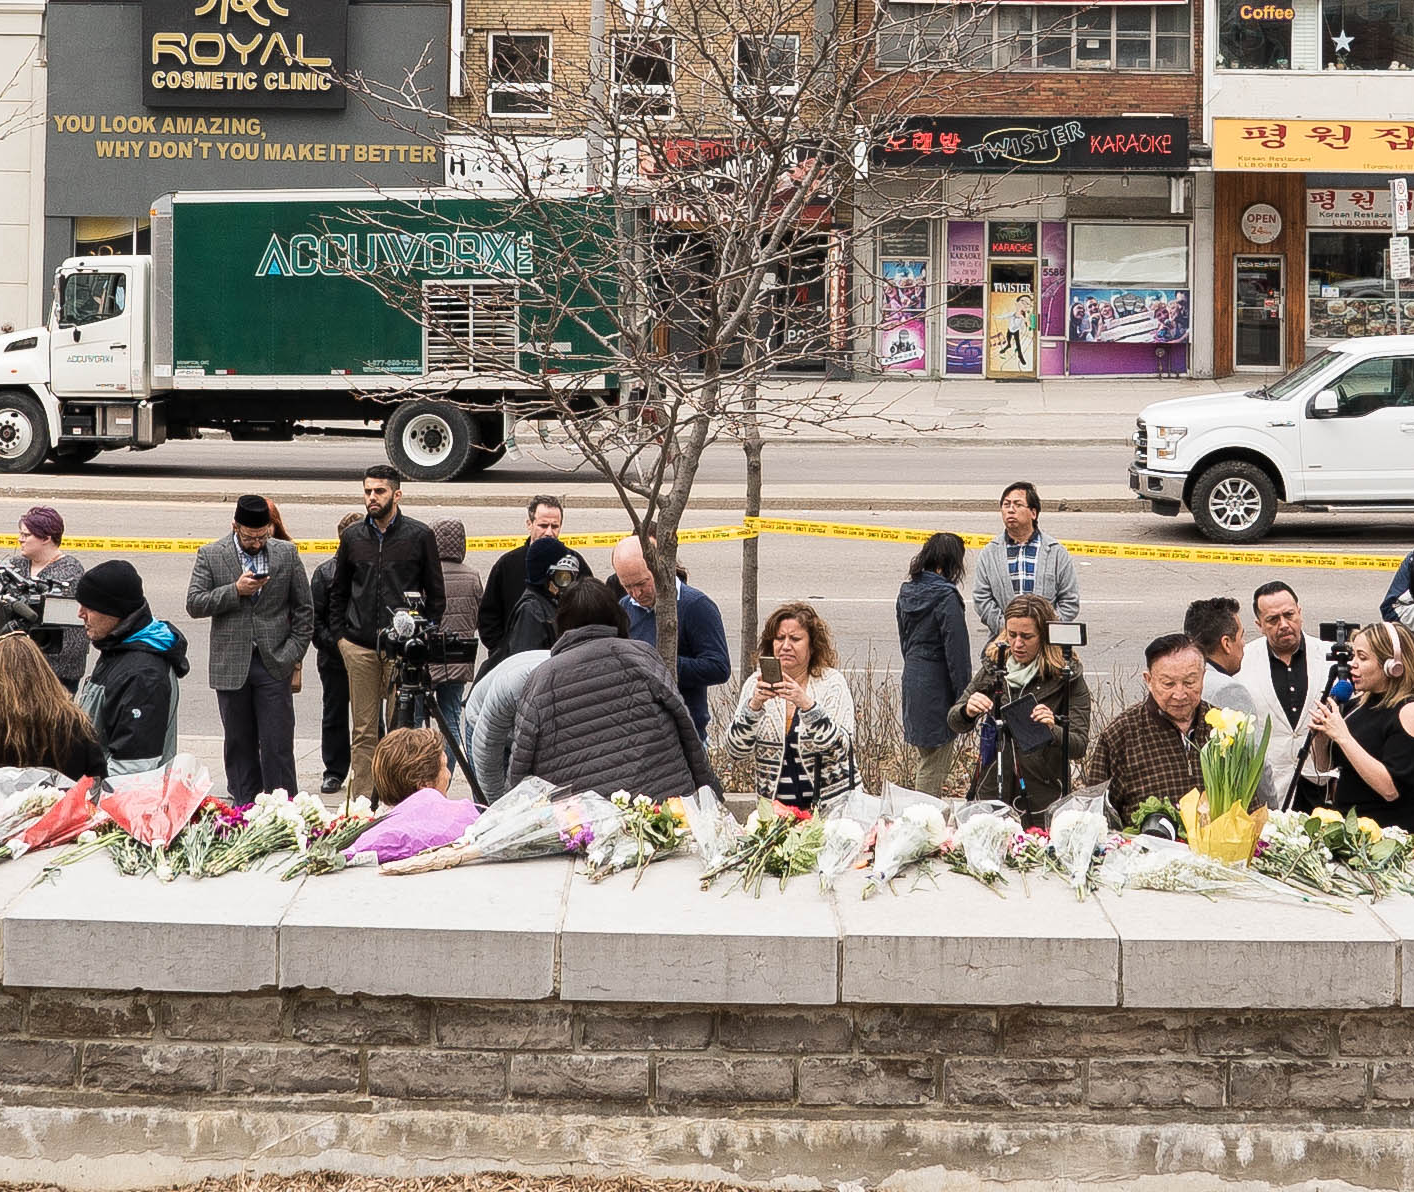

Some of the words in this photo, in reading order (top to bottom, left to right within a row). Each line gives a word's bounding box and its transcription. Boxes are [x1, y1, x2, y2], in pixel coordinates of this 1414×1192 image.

[1240, 5, 1295, 22] Coffee
[152, 32, 333, 66] ROYAL
[151, 71, 257, 91] COSMETIC
[263, 72, 332, 91] CLINIC
[53, 114, 95, 134] YOU
[99, 115, 158, 134] LOOK
[160, 118, 267, 142] AMAZING,
[95, 140, 144, 160] WHY
[147, 138, 213, 161] DON'T
[216, 142, 260, 161] YOU
[263, 143, 330, 162] MAKE
[330, 144, 352, 163] IT
[353, 144, 438, 164] BETTER
[967, 121, 1086, 164] TWISTER
[1089, 133, 1172, 155] KARAOKE
[1246, 213, 1277, 224] OPEN
[1318, 211, 1351, 219] Korean
[254, 232, 517, 277] ACCUWORX
[952, 244, 980, 252] TWISTER
[991, 242, 1034, 253] KARAOKE
[993, 282, 1033, 294] TWISTER
